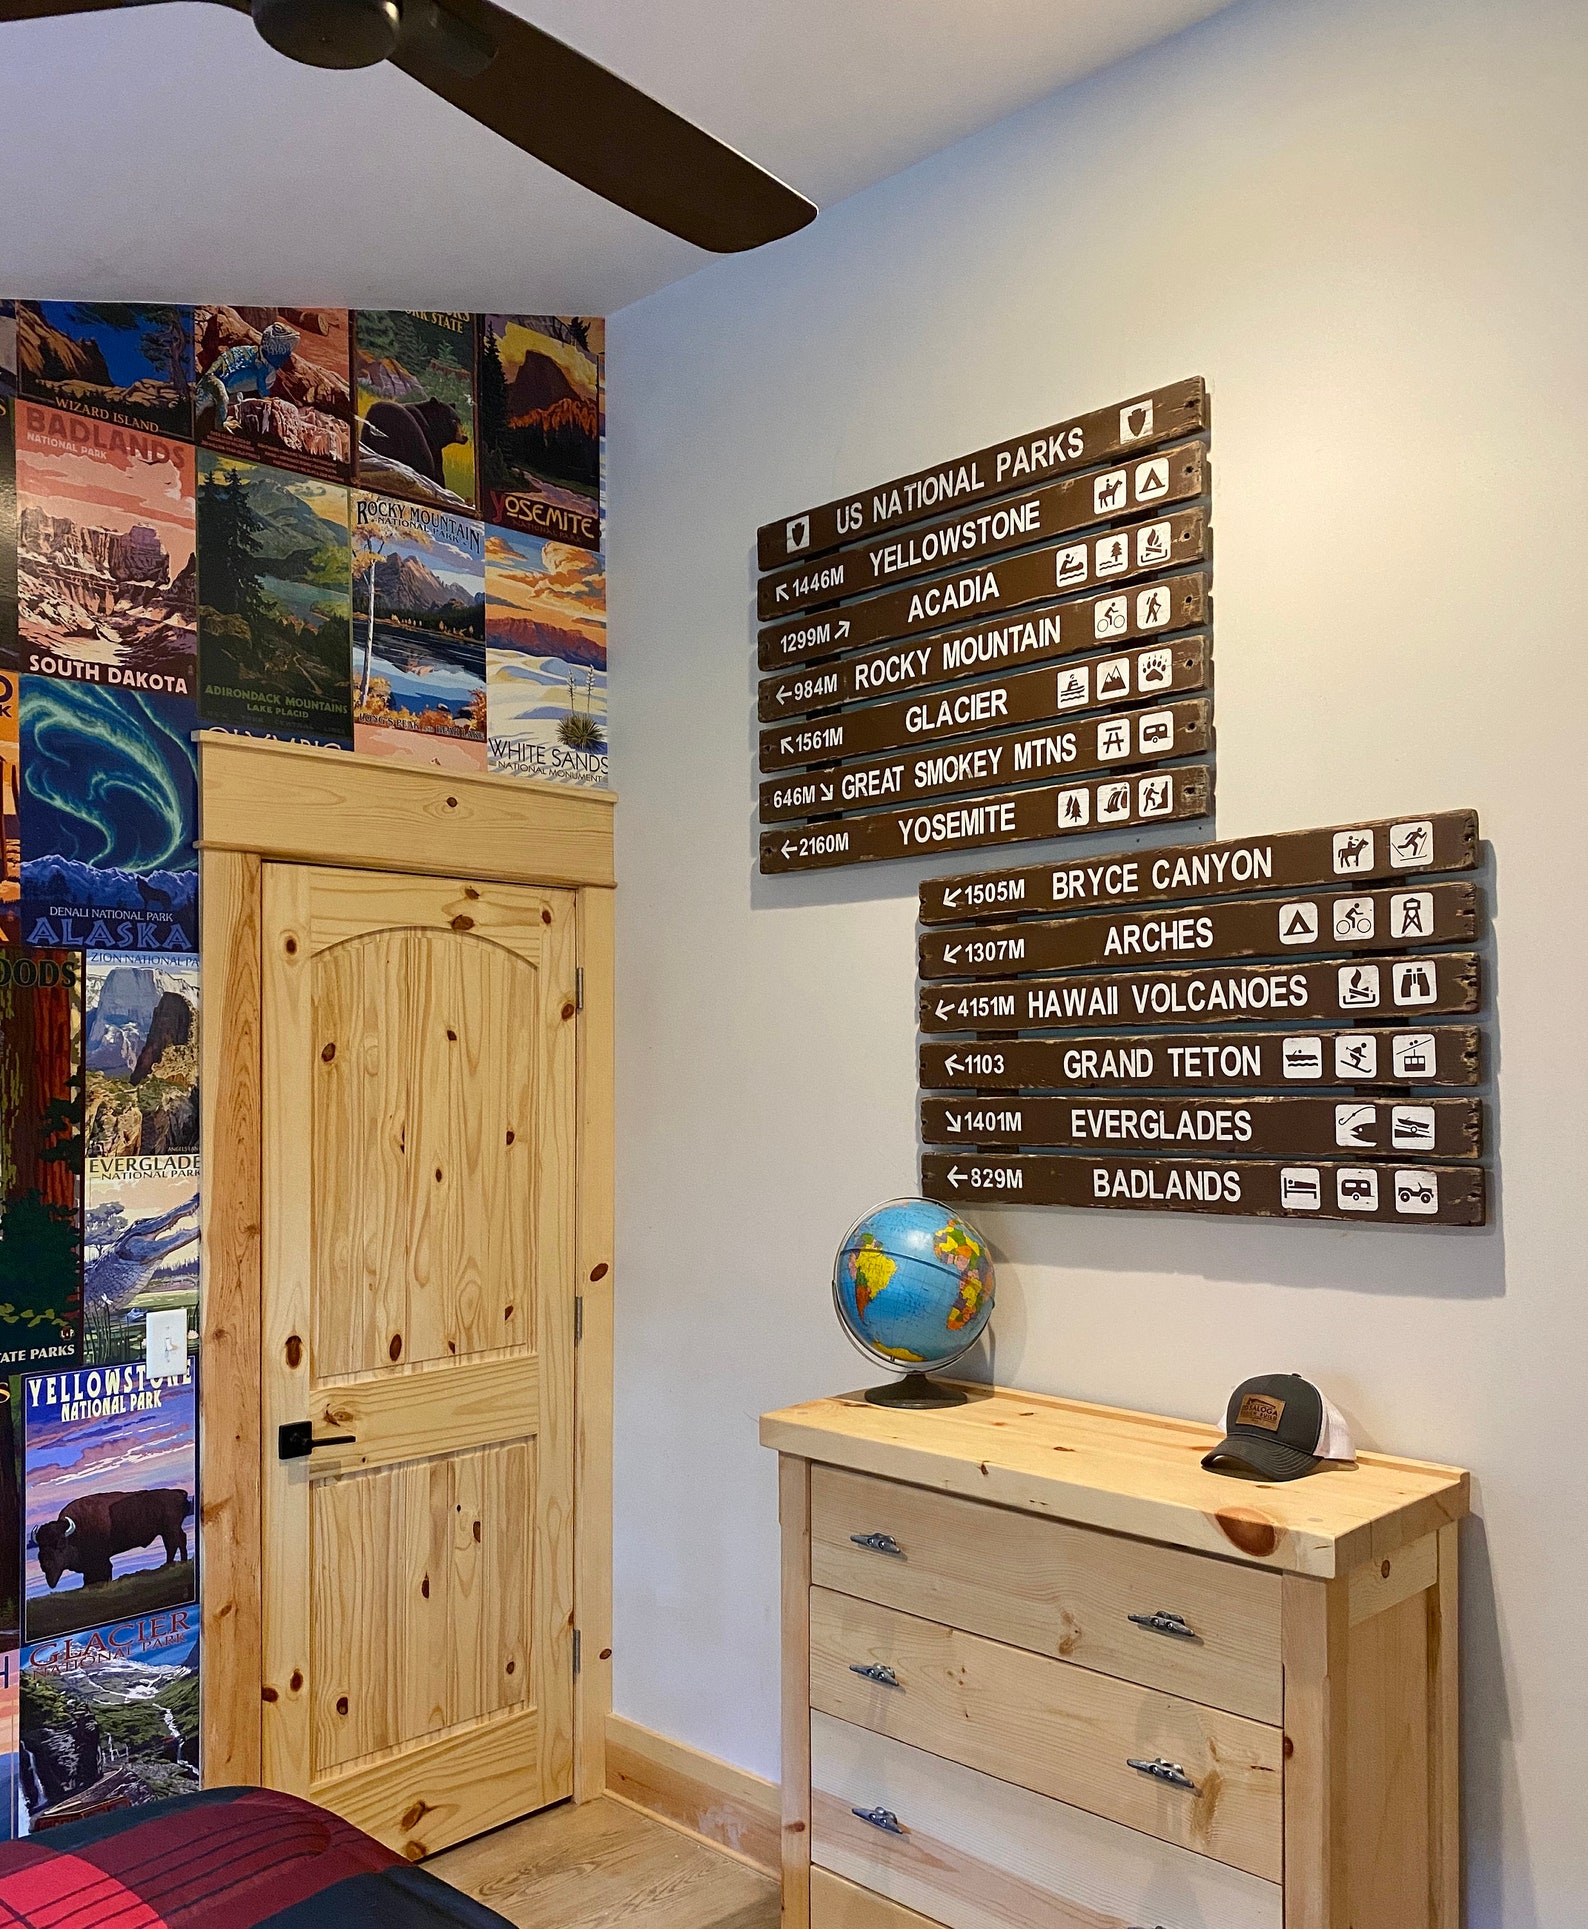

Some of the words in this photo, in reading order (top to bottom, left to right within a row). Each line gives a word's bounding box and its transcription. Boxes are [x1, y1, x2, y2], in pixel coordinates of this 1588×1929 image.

[430, 312, 463, 334] STATE
[55, 397, 109, 420] WIZARD
[113, 412, 159, 433] ISLAND
[26, 406, 185, 468] BADLANDS
[27, 432, 78, 453] NATIONAL
[81, 446, 107, 460] PARK
[837, 503, 862, 533] US
[874, 463, 984, 522] NATIONAL
[997, 428, 1083, 482] PARKS
[357, 501, 405, 524] ROCKY
[410, 507, 480, 554] MOUNTAIN
[378, 517, 430, 532] NATIONAL
[433, 528, 459, 543] PARK
[490, 490, 595, 539] YOSEMITE
[793, 565, 843, 596] 1446M
[870, 501, 1040, 576] YELLOWSTONE
[781, 624, 829, 652] 1299M
[908, 572, 999, 622] ACADIA
[29, 655, 100, 681] SOUTH
[108, 667, 188, 695] DAKOTA
[795, 674, 837, 700] 984M
[856, 647, 931, 690] ROCKY
[944, 615, 1060, 670] MOUNTAIN
[205, 685, 281, 704] ADIRONDACK
[285, 696, 348, 714] MOUNTAINS
[247, 704, 272, 714] LAKE
[276, 707, 309, 719] PLACID
[396, 719, 420, 730] PEAK
[796, 727, 842, 751] 1561M
[906, 688, 1008, 732] GLACIER
[488, 738, 546, 765] WHITE
[552, 748, 608, 774] SANDS
[498, 760, 547, 775] NATIONAL
[549, 768, 602, 782] MONUMENT
[774, 785, 815, 808] 646M
[842, 766, 904, 799] GREAT
[915, 747, 1002, 787] SMOKEY
[1015, 733, 1076, 770] MTNS
[800, 833, 848, 856] 2160M
[898, 803, 1015, 844] YOSEMITE
[965, 879, 1024, 904] 1505M
[1053, 863, 1138, 900] BRYCE
[1152, 847, 1271, 889] CANYON
[50, 906, 89, 918] DENALI
[92, 908, 145, 921] NATIONAL
[146, 911, 174, 922] PARK
[26, 917, 192, 950] ALASKA
[965, 939, 1024, 962] 1307M
[1104, 918, 1213, 955] ARCHES
[90, 951, 122, 963] ZION
[125, 953, 183, 966] NATIONAL
[958, 996, 1014, 1017] 4151M
[1029, 986, 1117, 1018] HAWAII
[1132, 975, 1308, 1013] VOLCANOES
[965, 1055, 1004, 1073] 1103
[1064, 1049, 1153, 1078] GRAND
[1168, 1046, 1260, 1077] TETON
[965, 1112, 1021, 1131] 1401M
[1072, 1110, 1252, 1141] EVERGLADES
[102, 1171, 168, 1180] NATIONAL
[171, 1170, 200, 1178] PARK
[971, 1168, 1022, 1188] 829M
[1094, 1169, 1240, 1201] BADLANDS
[30, 1344, 75, 1360] PARKS
[61, 1394, 127, 1422] NATIONAL
[130, 1389, 162, 1412] PARK
[29, 1611, 190, 1667] GLACIER
[33, 1646, 133, 1680] NATIONAL
[142, 1633, 187, 1651] PARK
